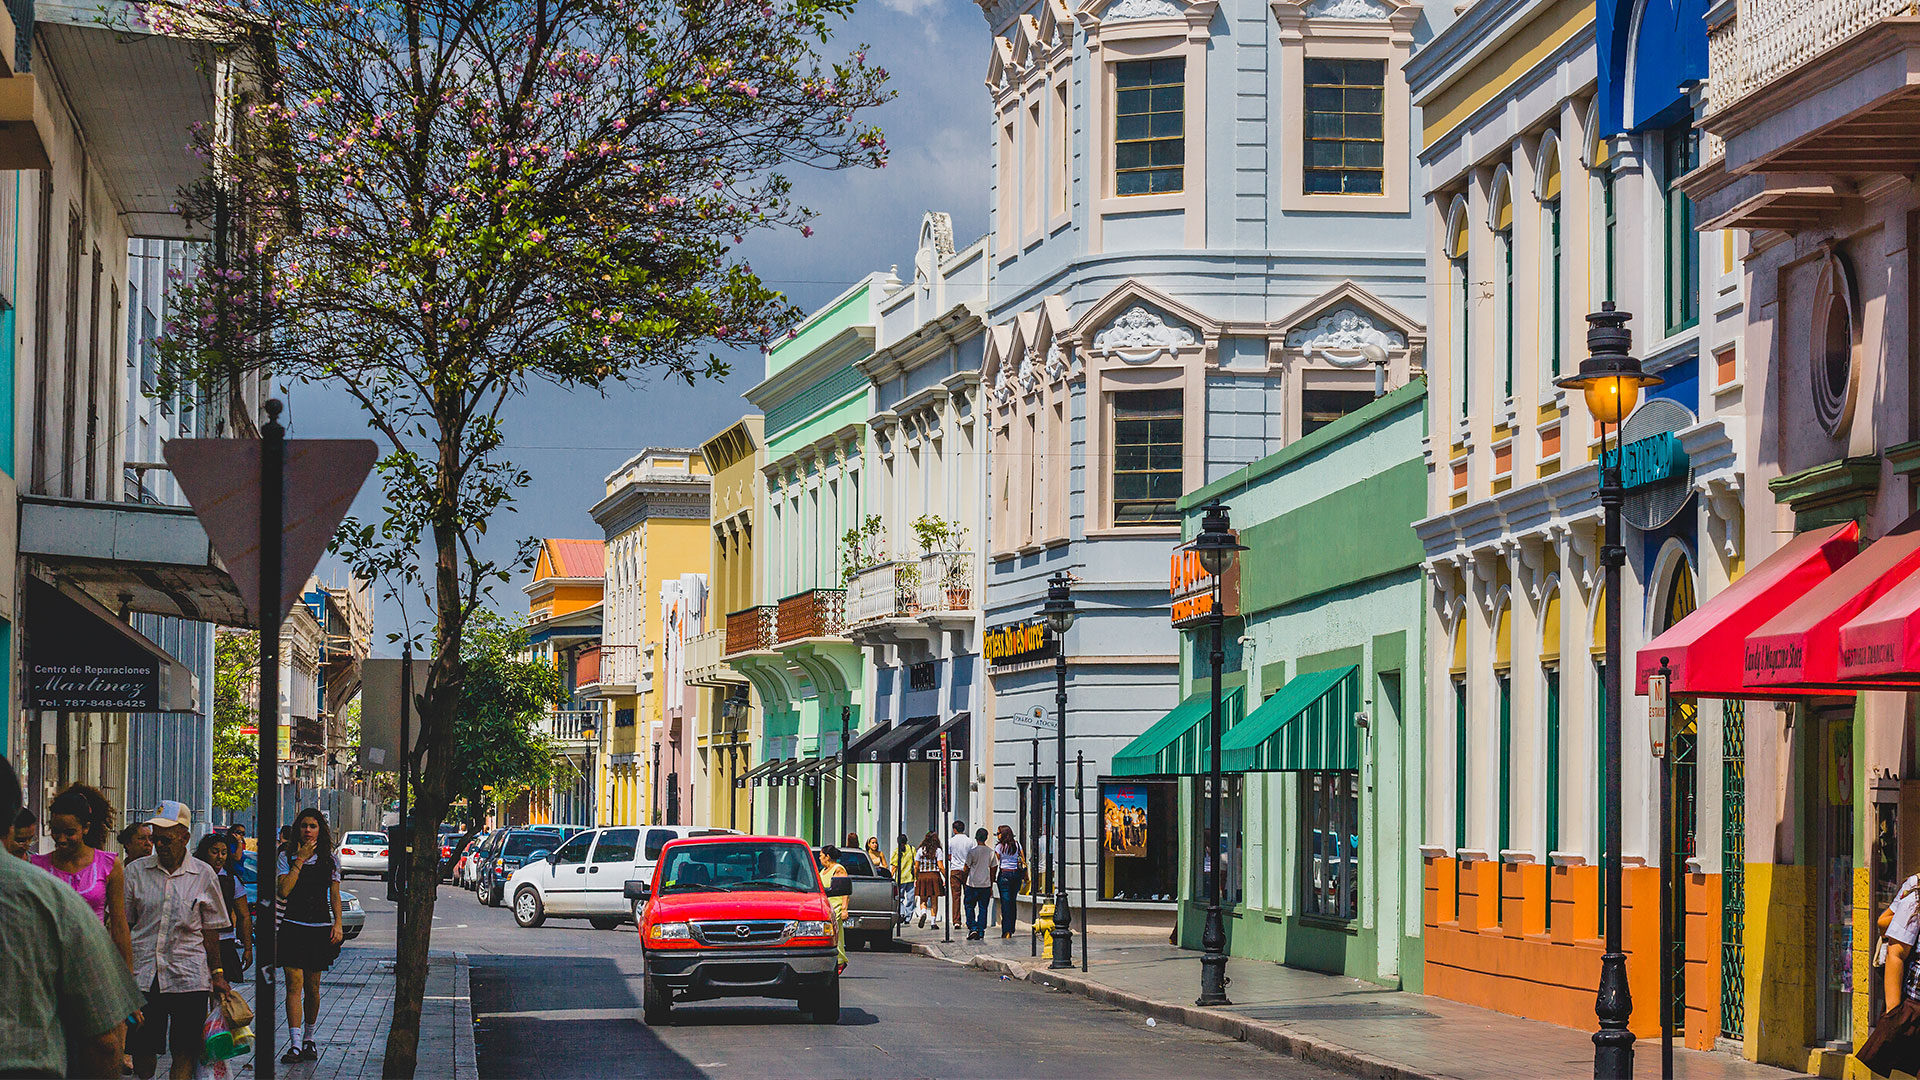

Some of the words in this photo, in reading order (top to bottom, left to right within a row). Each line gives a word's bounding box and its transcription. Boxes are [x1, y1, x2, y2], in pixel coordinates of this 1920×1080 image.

[983, 628, 1004, 665] Payless
[1005, 622, 1044, 657] ShoeSource
[34, 664, 67, 674] Centro
[70, 664, 81, 674] de
[84, 664, 150, 675] Reparaciones
[38, 699, 60, 707] Tel.
[64, 699, 146, 708] 787-848-6425
